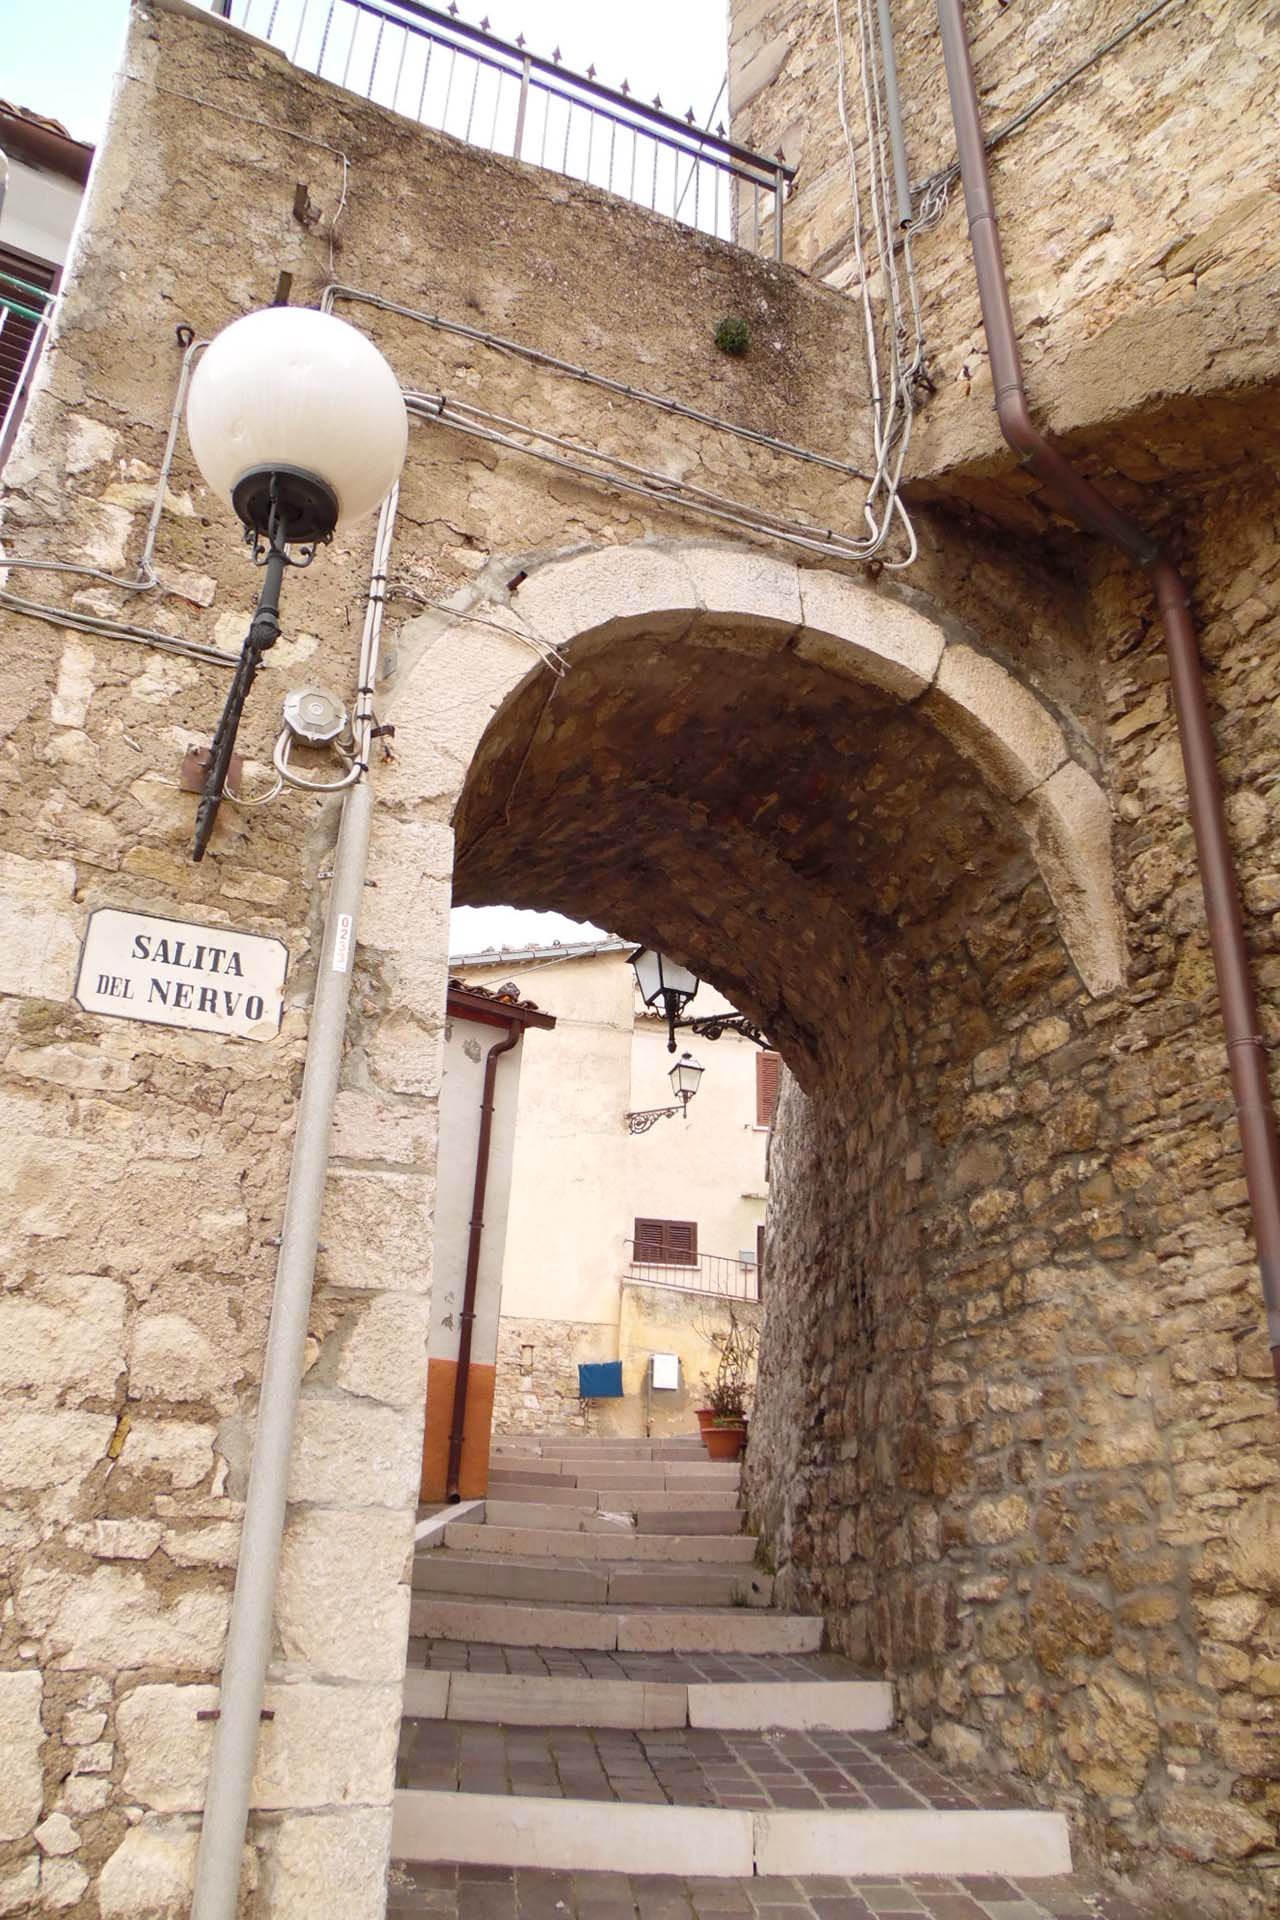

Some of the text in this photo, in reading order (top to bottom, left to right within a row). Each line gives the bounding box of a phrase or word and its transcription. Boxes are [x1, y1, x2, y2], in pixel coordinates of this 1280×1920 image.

[131, 934, 245, 977] SALITA
[95, 974, 265, 1021] DEL NERVO
